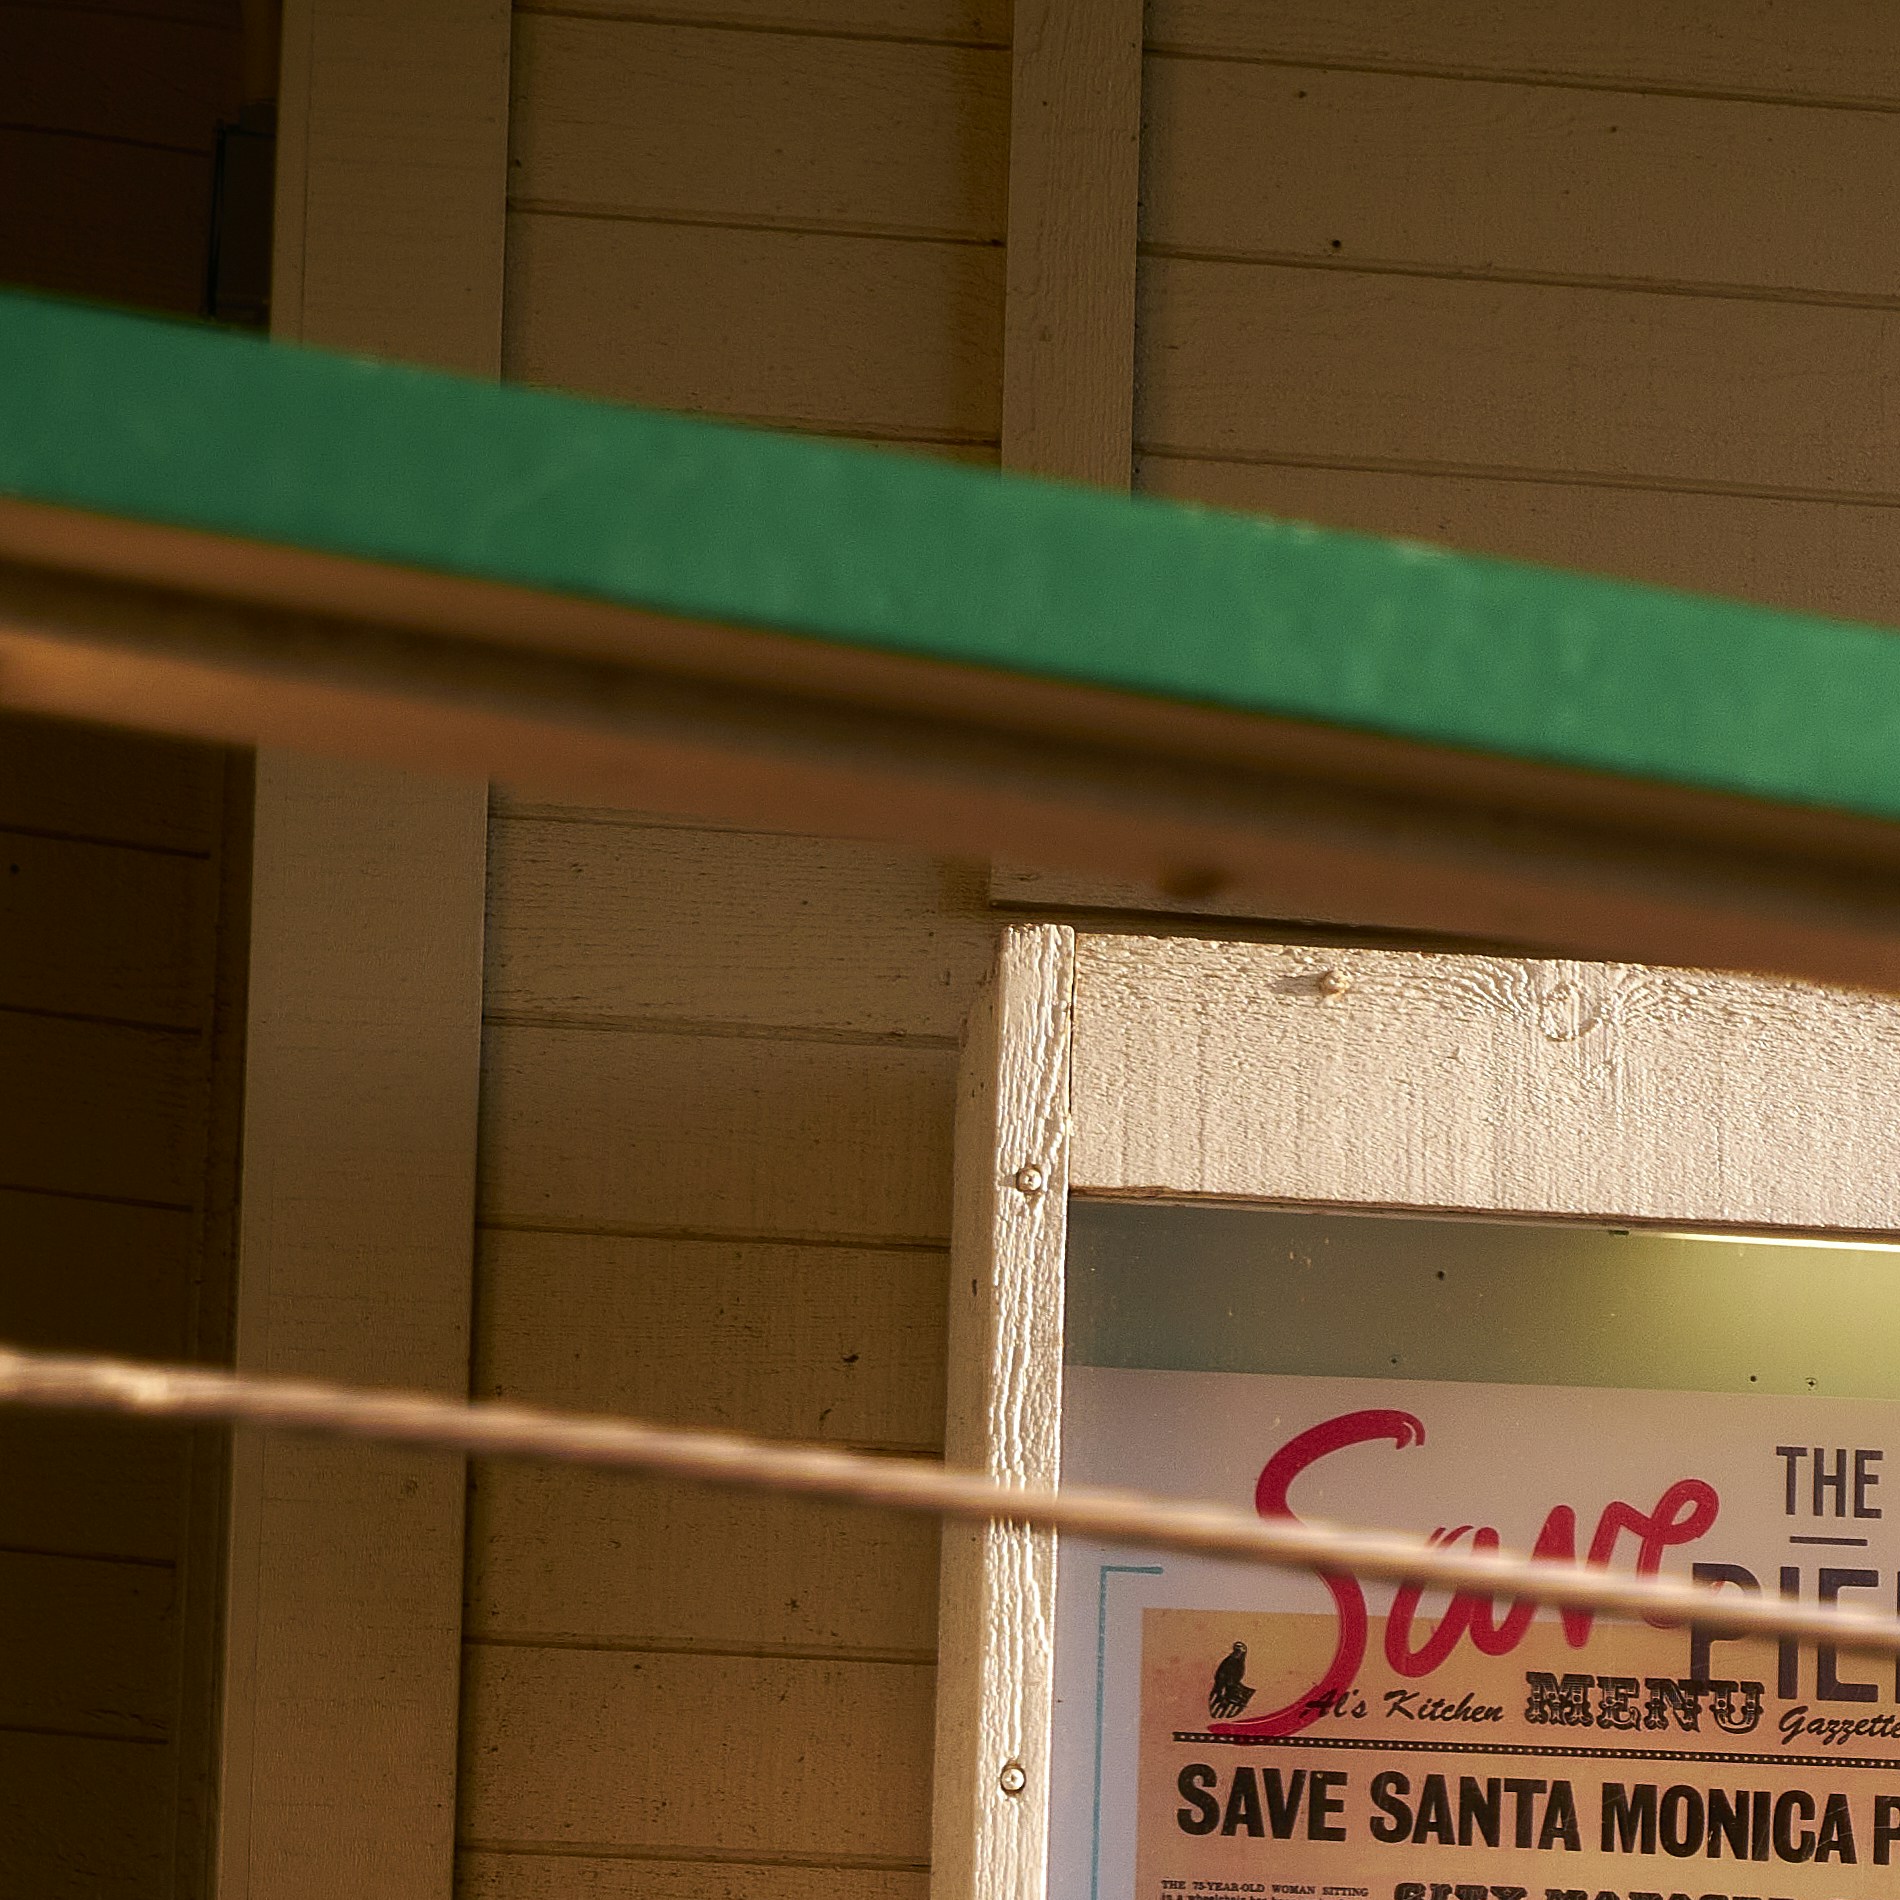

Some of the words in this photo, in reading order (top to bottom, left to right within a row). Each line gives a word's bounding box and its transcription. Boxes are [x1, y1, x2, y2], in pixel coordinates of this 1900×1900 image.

[1775, 1445, 1884, 1520] THE
[1209, 1410, 1720, 1744] Save
[1301, 1688, 1367, 1720] Al's
[1385, 1688, 1505, 1722] Kitchen
[1524, 1671, 1765, 1735] MENU
[1176, 1763, 1349, 1843] SAVE
[1368, 1770, 1583, 1852] SANTA
[1599, 1781, 1858, 1865] MONICA
